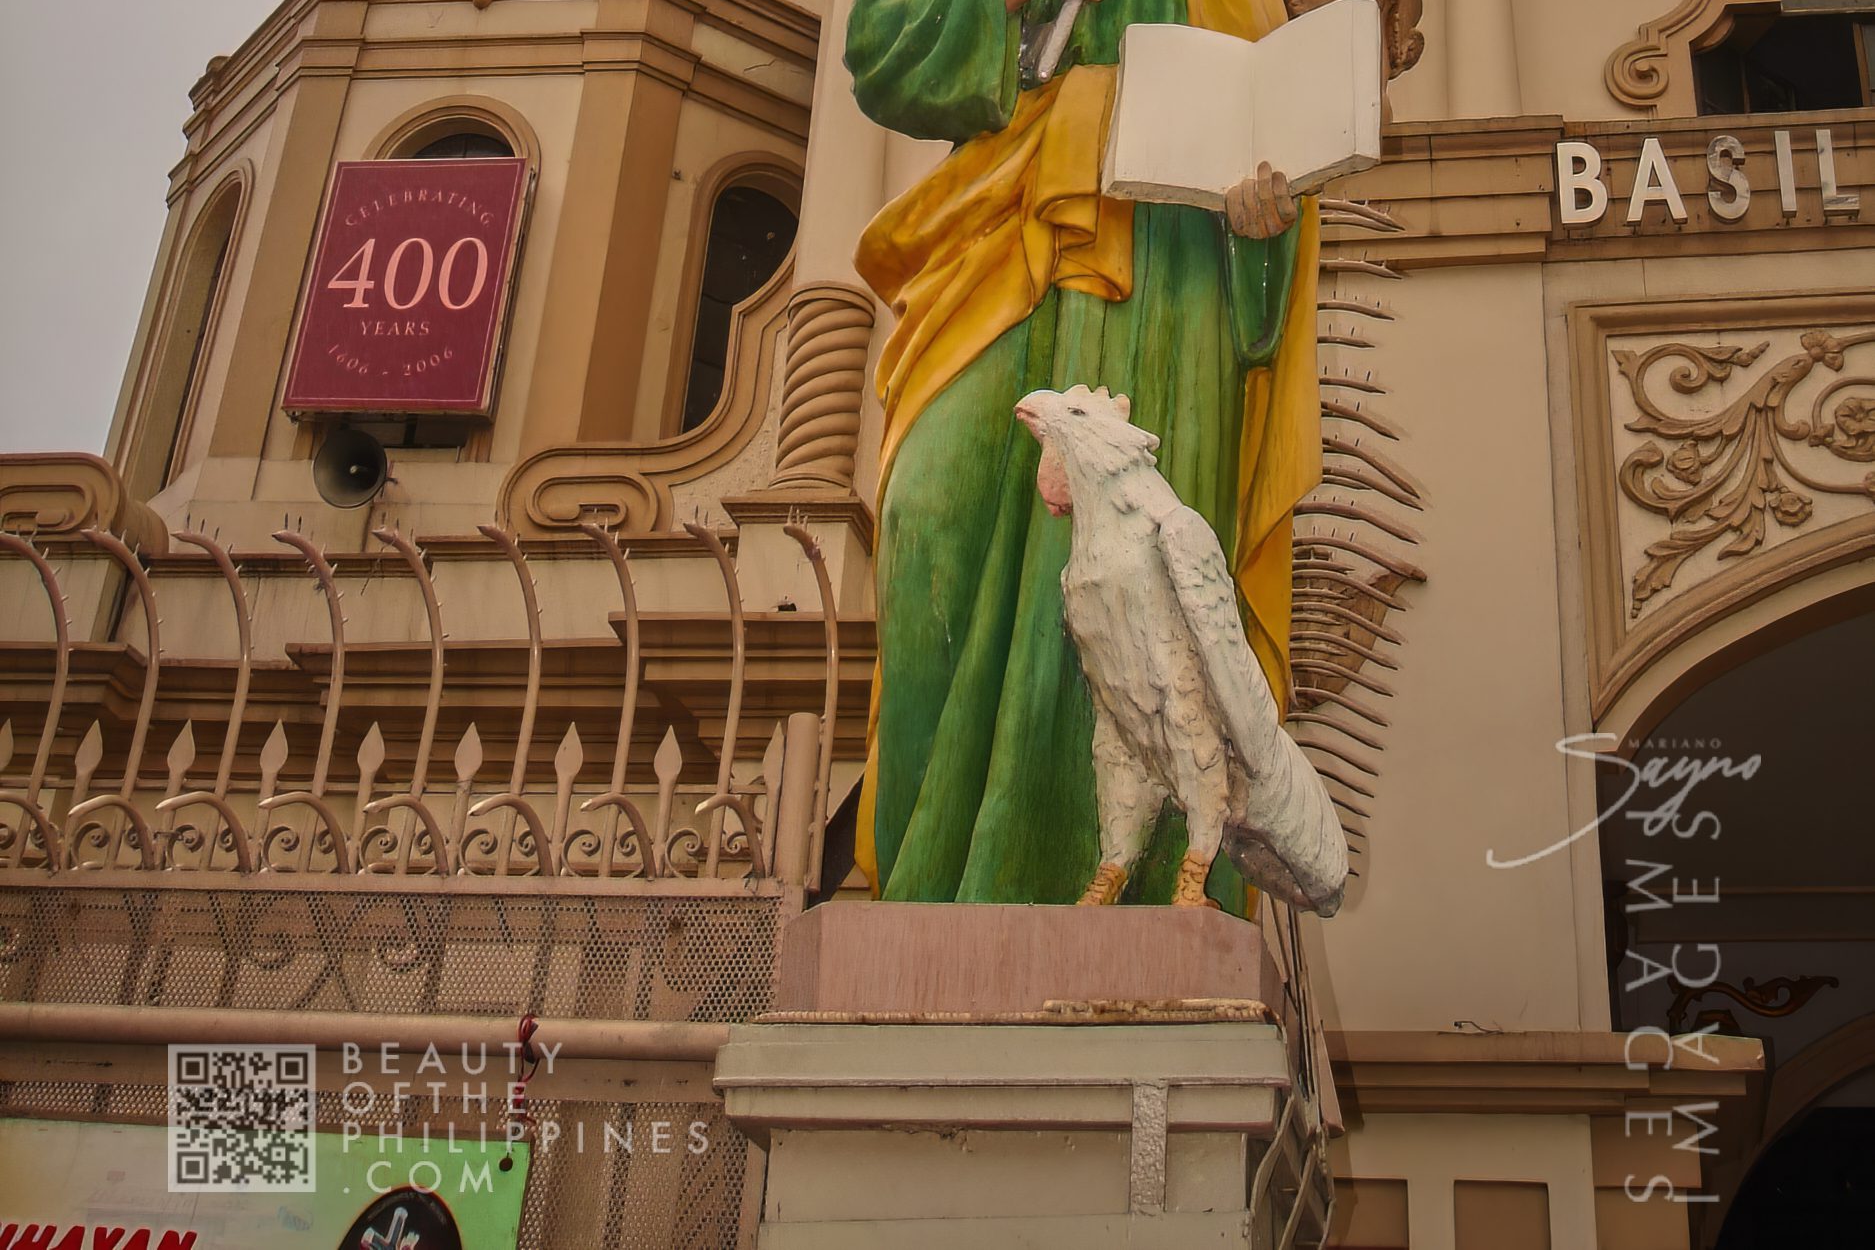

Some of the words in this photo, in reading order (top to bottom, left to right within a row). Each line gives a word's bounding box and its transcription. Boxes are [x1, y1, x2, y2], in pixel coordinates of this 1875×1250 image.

[1555, 129, 1860, 227] BASIL
[344, 188, 497, 228] CELEBRATING
[327, 237, 488, 310] 400
[360, 320, 431, 336] YEARS
[328, 343, 369, 375] 1606
[403, 349, 453, 376] 2006
